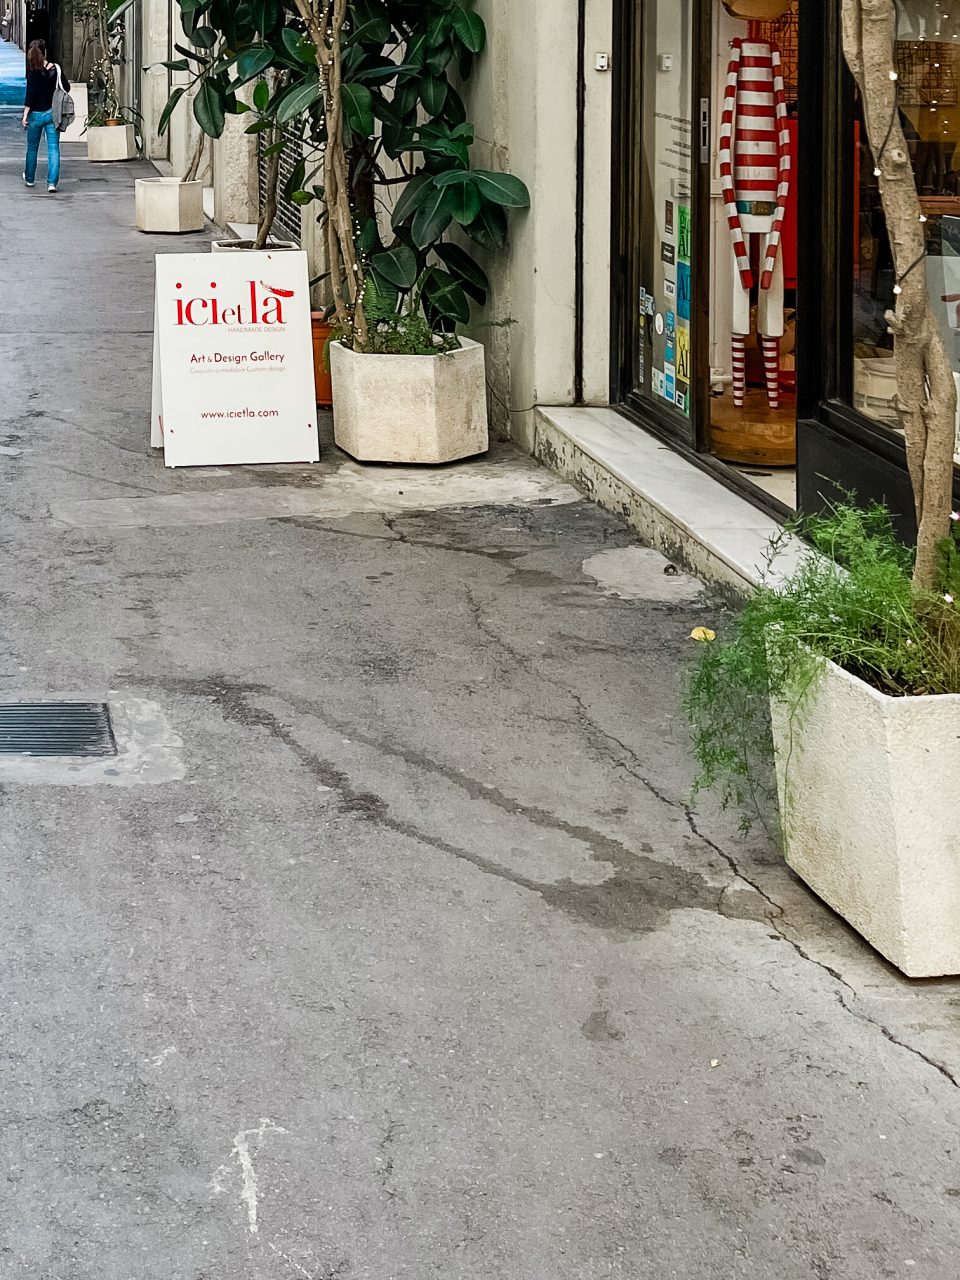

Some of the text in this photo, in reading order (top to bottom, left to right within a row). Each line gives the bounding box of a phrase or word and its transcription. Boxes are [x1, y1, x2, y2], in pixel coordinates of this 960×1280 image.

[190, 353, 206, 364] Art
[214, 352, 247, 365] Design
[249, 350, 285, 363] Gallery
[200, 407, 279, 419] www.icietla.com
